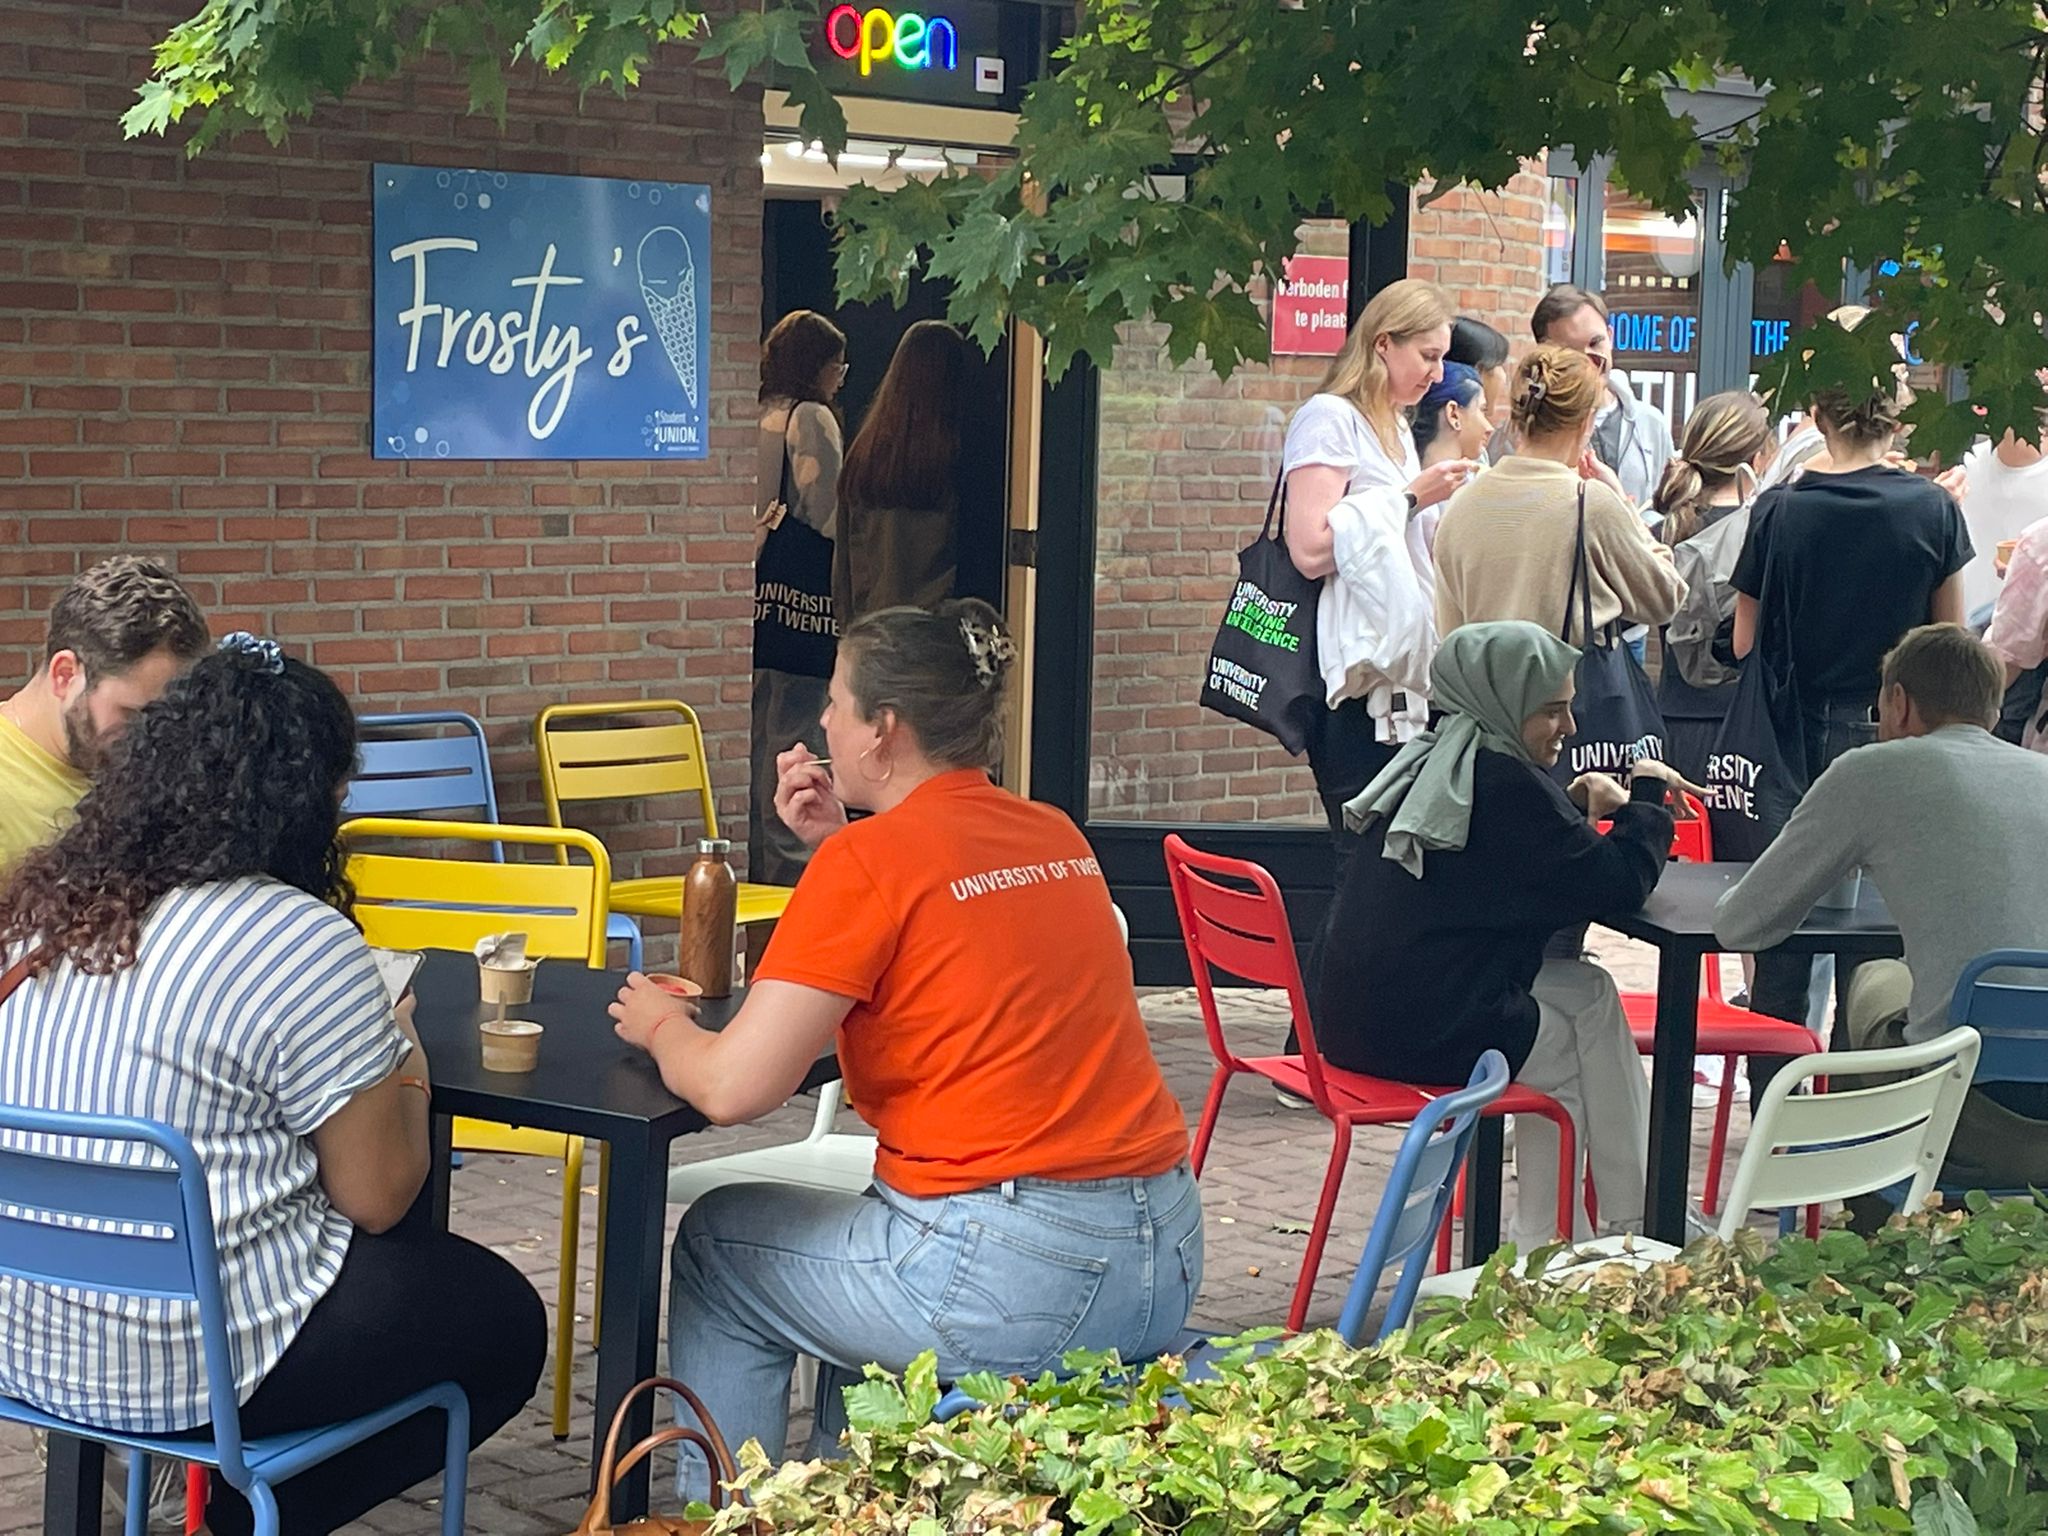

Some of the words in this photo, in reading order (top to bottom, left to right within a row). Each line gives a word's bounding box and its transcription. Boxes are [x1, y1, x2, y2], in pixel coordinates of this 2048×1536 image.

[826, 3, 958, 76] open
[1295, 309, 1308, 327] te
[1670, 315, 1697, 353] OF
[391, 237, 648, 439] Frosty's
[754, 582, 833, 614] UNIVERSIT
[1231, 596, 1249, 612] OF
[1210, 673, 1222, 690] OF
[950, 864, 1048, 902] UNIVERSITY
[1048, 861, 1069, 880] OF
